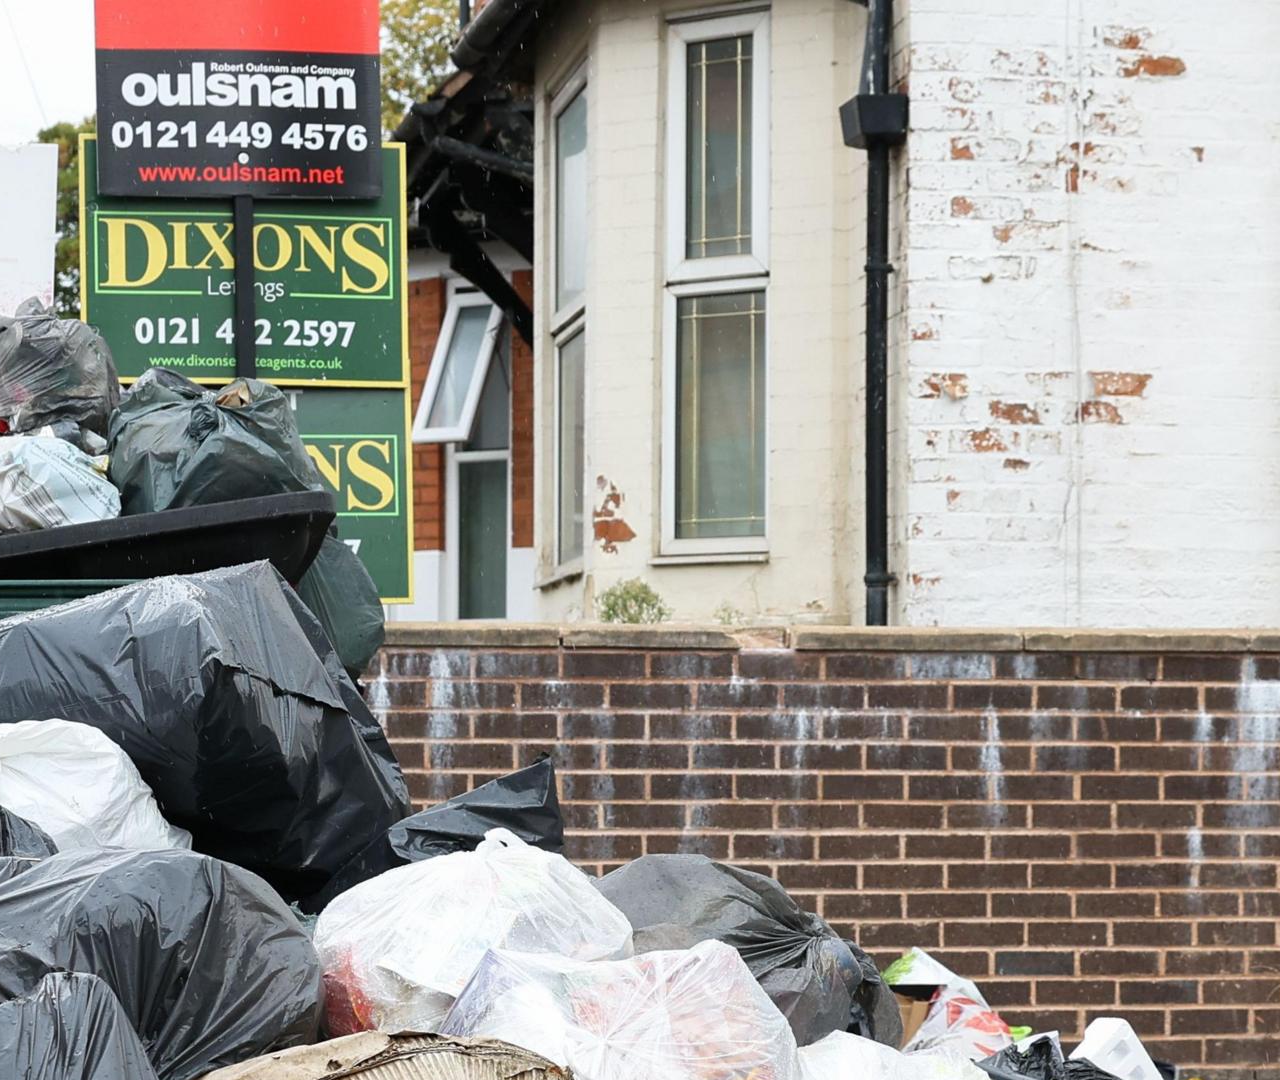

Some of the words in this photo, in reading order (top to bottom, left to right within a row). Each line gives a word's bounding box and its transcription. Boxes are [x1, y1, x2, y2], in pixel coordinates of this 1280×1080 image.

[210, 63, 244, 72] Robert
[246, 64, 289, 73] Oulsnam
[291, 65, 308, 74] and
[310, 65, 355, 77] Company
[121, 62, 357, 110] oulsnam
[111, 121, 197, 148] 0121
[205, 121, 273, 149] 449
[281, 123, 368, 152] 4576
[138, 162, 344, 184] www.oulsnam.net
[208, 275, 284, 302] Letngs
[135, 317, 199, 344] 0121
[216, 318, 273, 345] 42
[282, 319, 356, 347] 2597
[149, 354, 343, 371] www.dixonseteagents.co.uk
